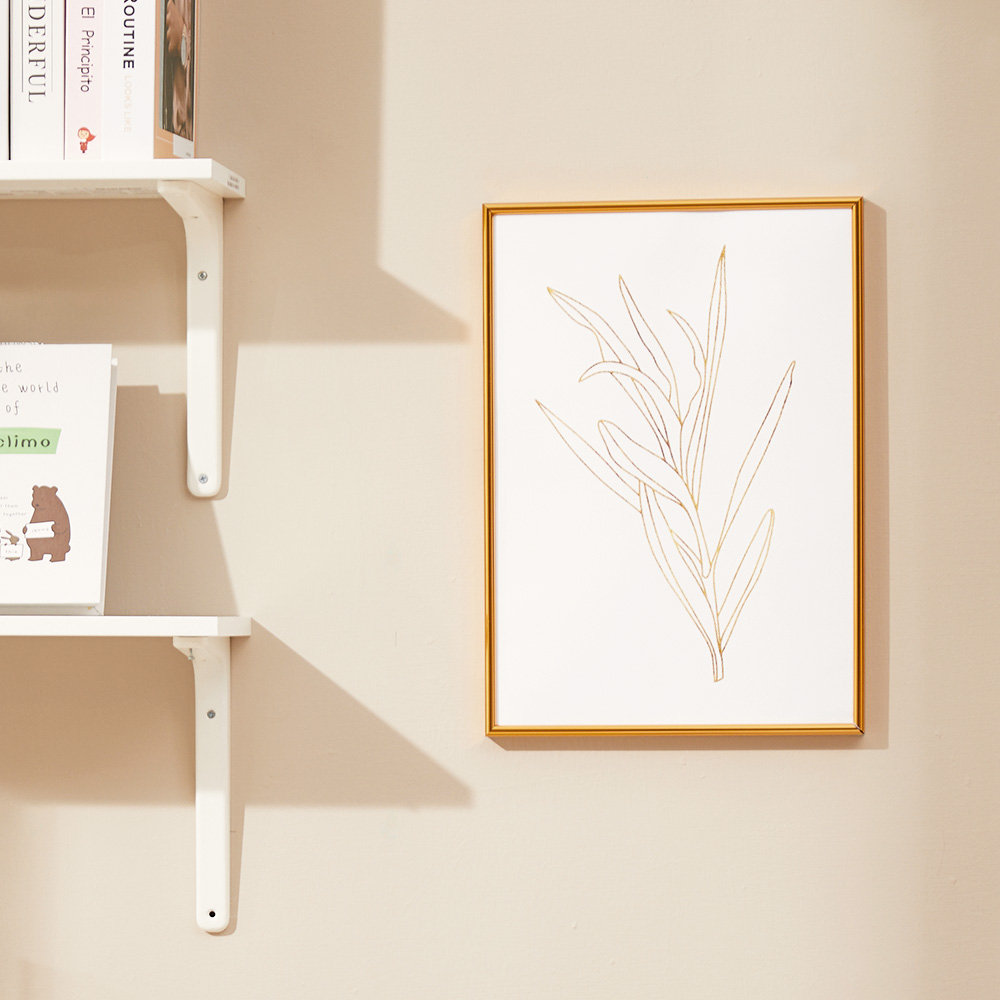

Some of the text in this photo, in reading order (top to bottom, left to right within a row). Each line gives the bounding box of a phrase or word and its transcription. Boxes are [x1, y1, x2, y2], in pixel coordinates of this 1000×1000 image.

[28, 0, 46, 103] DERFUL
[77, 6, 96, 93] El Principito
[5, 399, 20, 416] of
[18, 381, 59, 393] world
